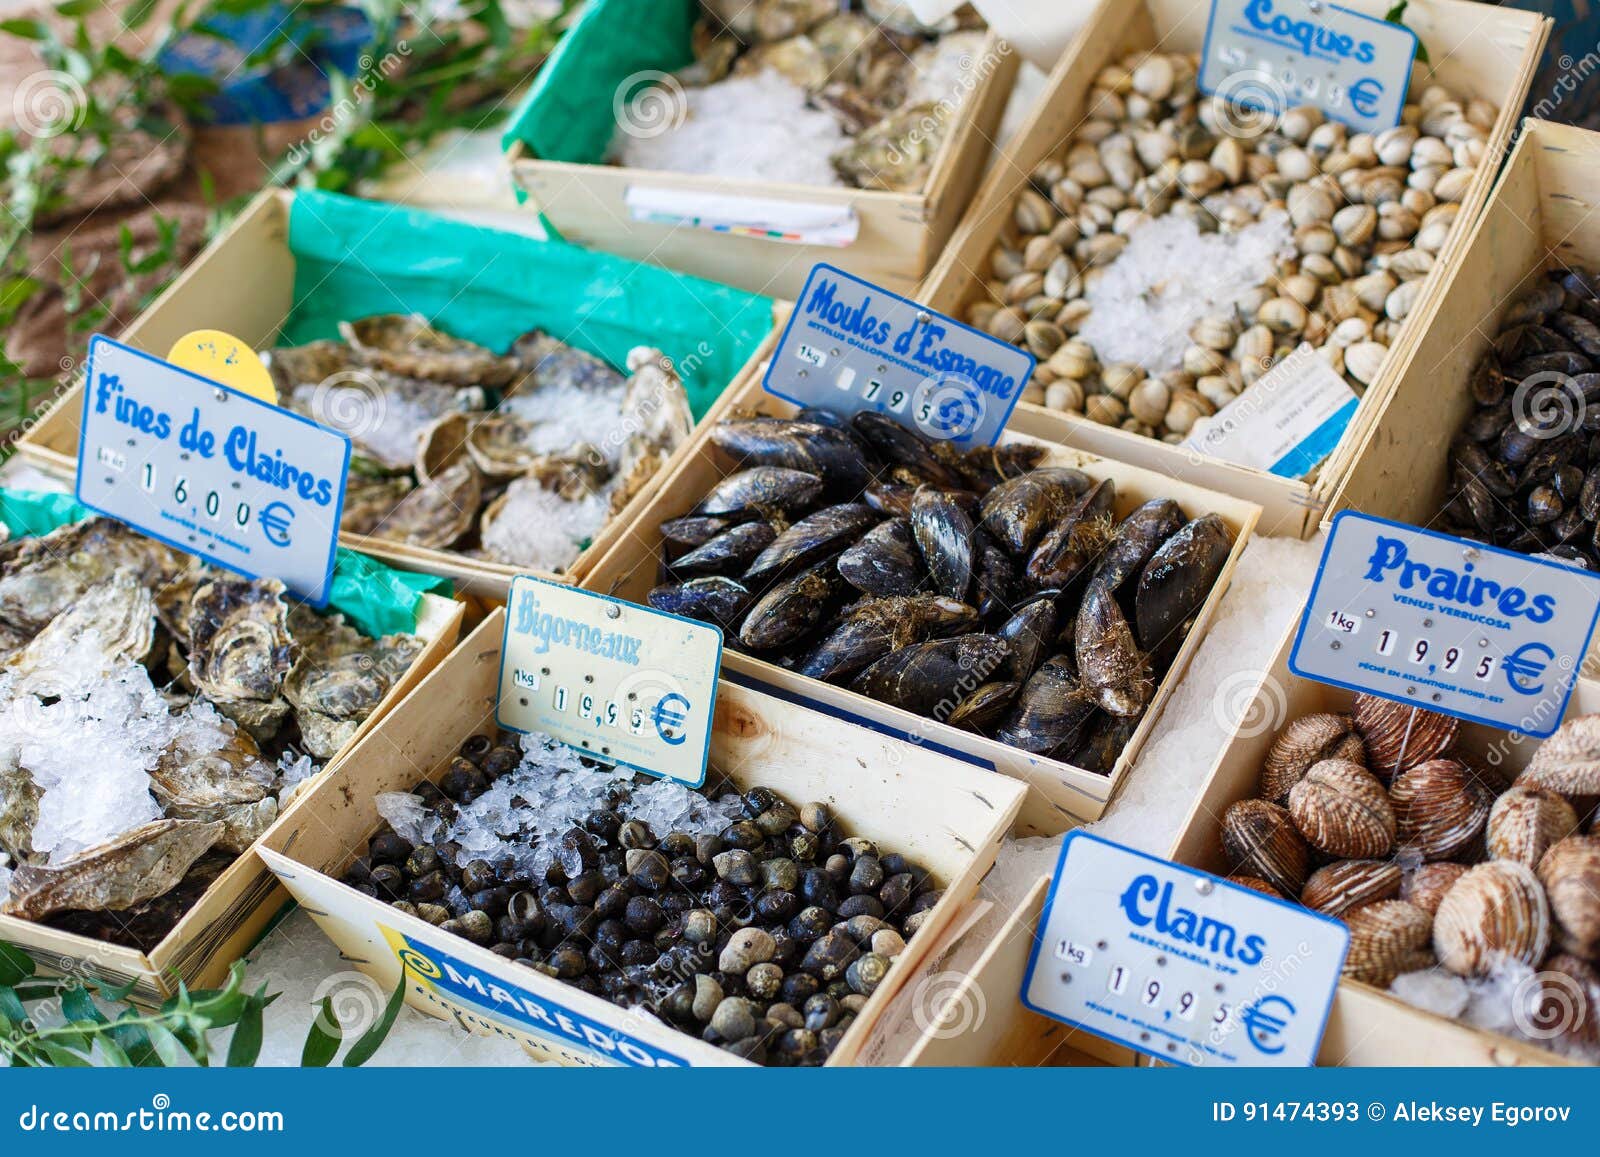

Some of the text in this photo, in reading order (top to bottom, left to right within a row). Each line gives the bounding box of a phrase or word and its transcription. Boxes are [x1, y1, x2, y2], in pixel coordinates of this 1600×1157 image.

[1244, 0, 1375, 63] Coques
[806, 278, 1015, 400] Moules d'Espagne
[95, 372, 332, 506] Fines de Claires
[1363, 535, 1556, 624] Praires
[515, 588, 642, 666] Bigorneaux
[1329, 610, 1355, 632] 1kg
[1393, 593, 1511, 631] VENUS VERRUCOSA
[515, 669, 535, 687] 1kg
[1060, 940, 1085, 963] 1kg
[1119, 874, 1268, 966] Clams
[1128, 931, 1210, 967] MERCENARIA
